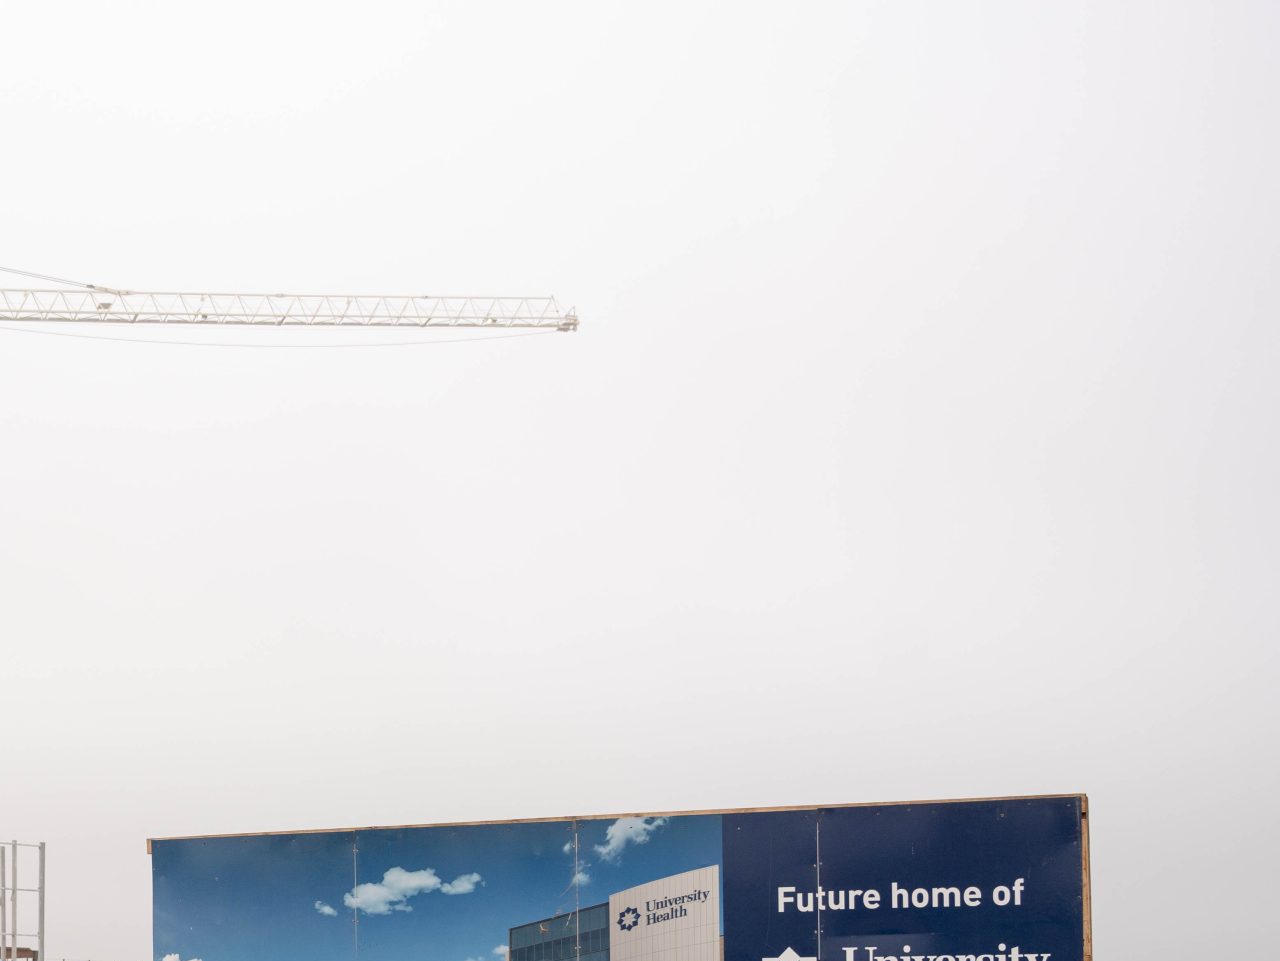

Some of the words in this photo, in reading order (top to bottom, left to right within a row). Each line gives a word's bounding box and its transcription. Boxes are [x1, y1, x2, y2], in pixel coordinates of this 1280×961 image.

[645, 889, 710, 913] University
[777, 886, 881, 912] Future
[891, 882, 982, 909] home
[992, 877, 1025, 906] of
[646, 905, 688, 926] Health
